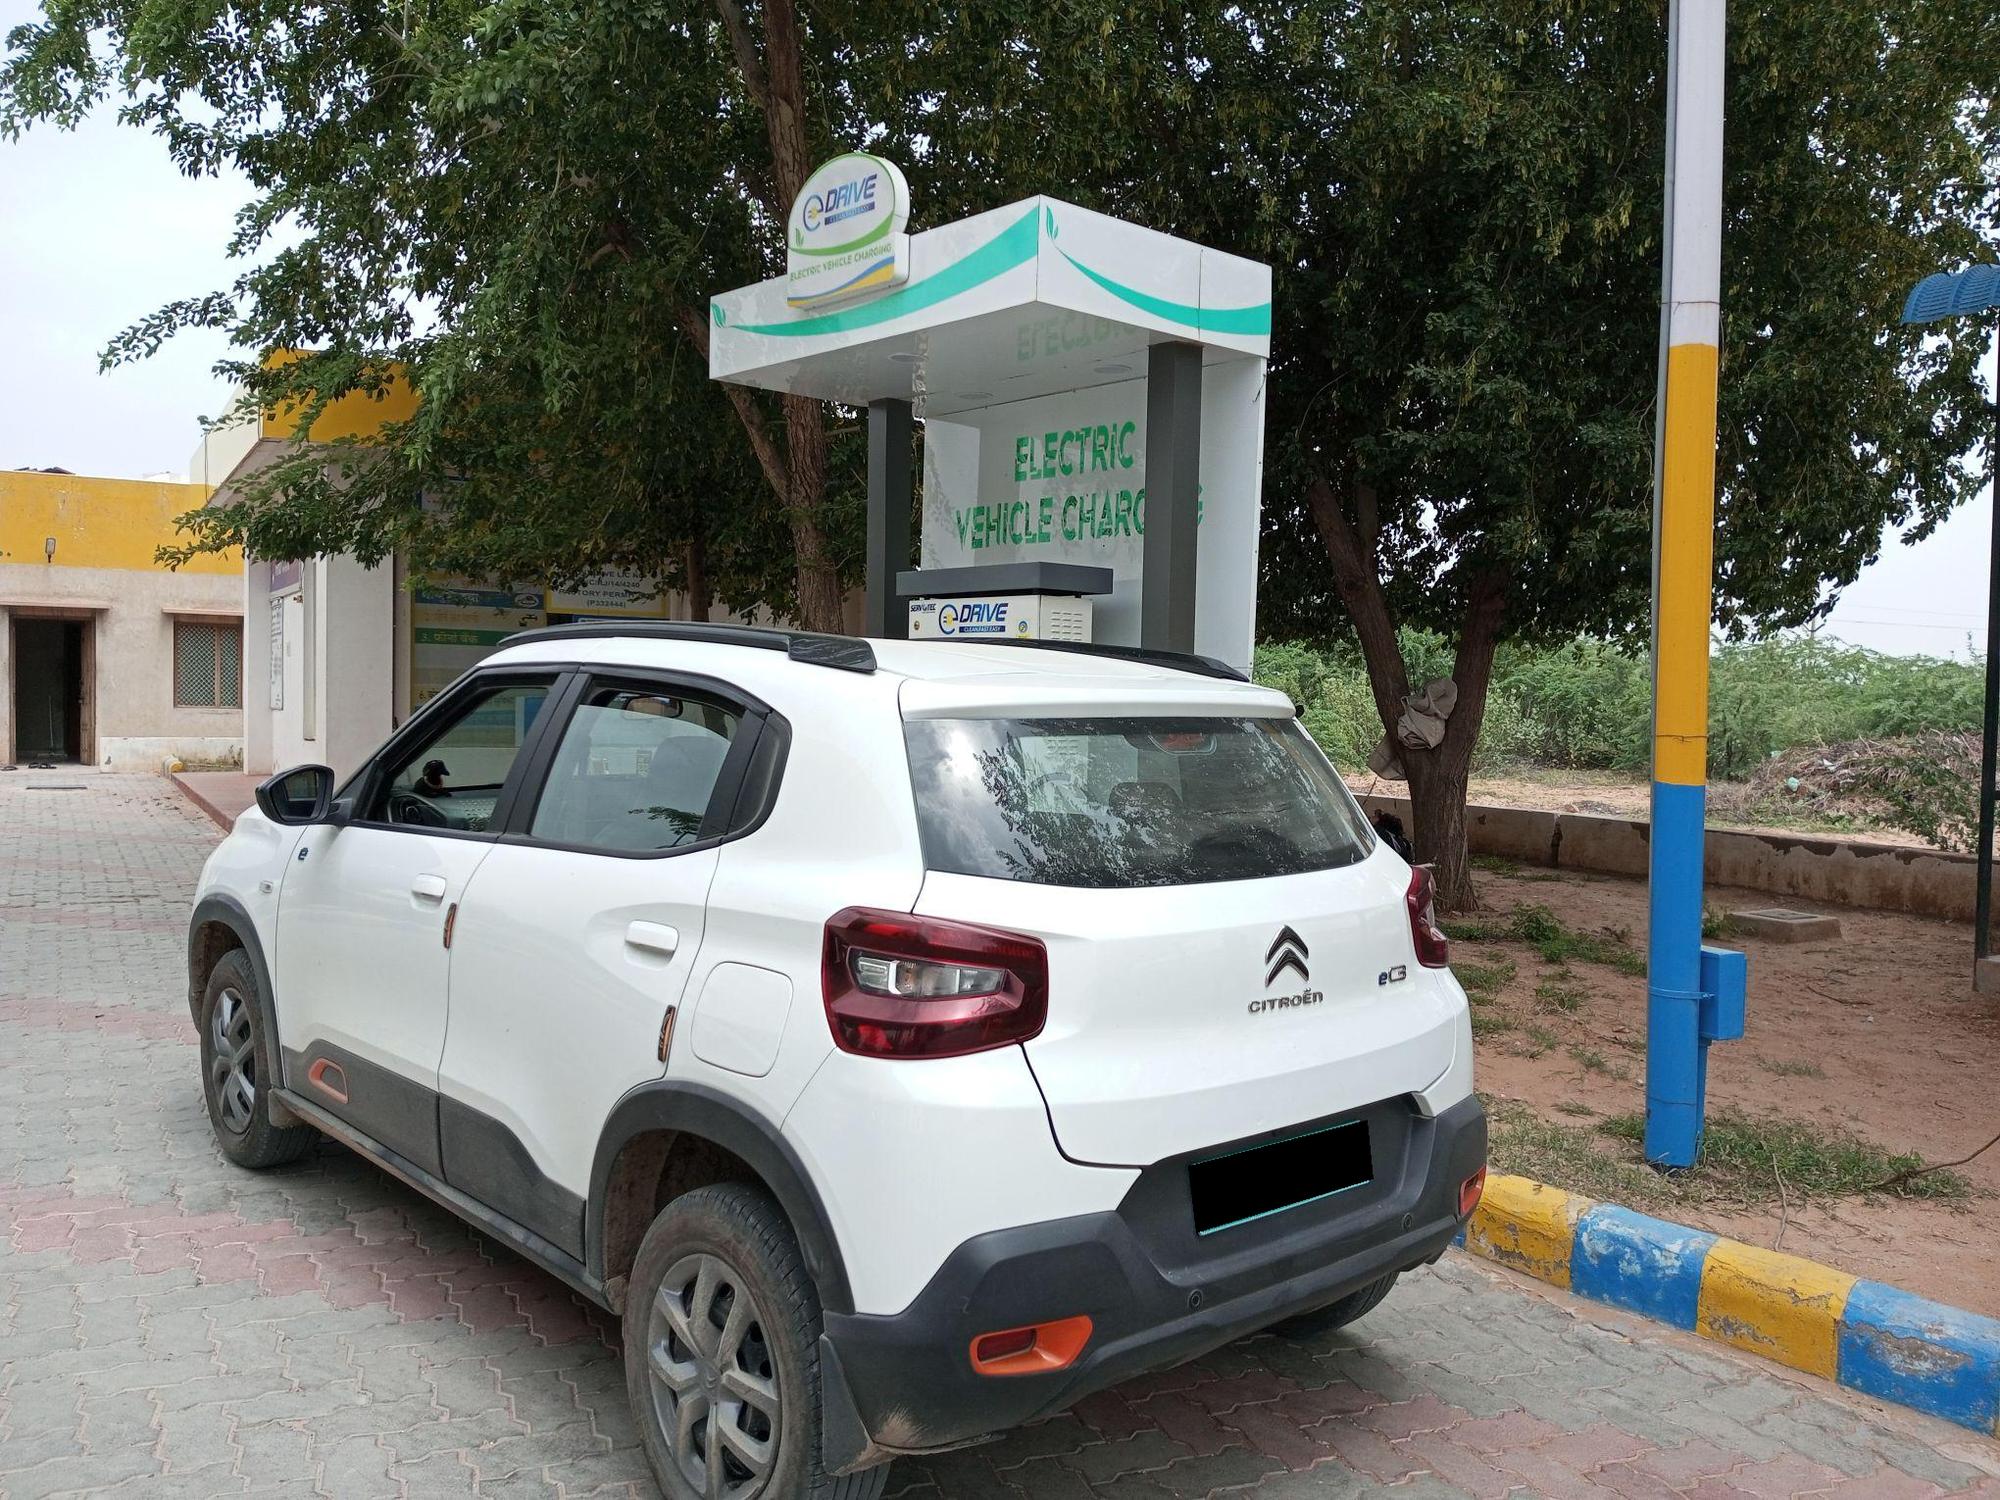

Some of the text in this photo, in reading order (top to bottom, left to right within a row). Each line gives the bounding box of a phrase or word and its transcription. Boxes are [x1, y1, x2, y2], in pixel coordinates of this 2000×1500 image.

[825, 173, 878, 213] DRIVE
[789, 243, 892, 281] ELECTRIC VEHICLE CHARGING
[1014, 421, 1136, 482] ELECTRIC
[956, 497, 1053, 551] VEHICLE
[959, 603, 1009, 623] DRIVE
